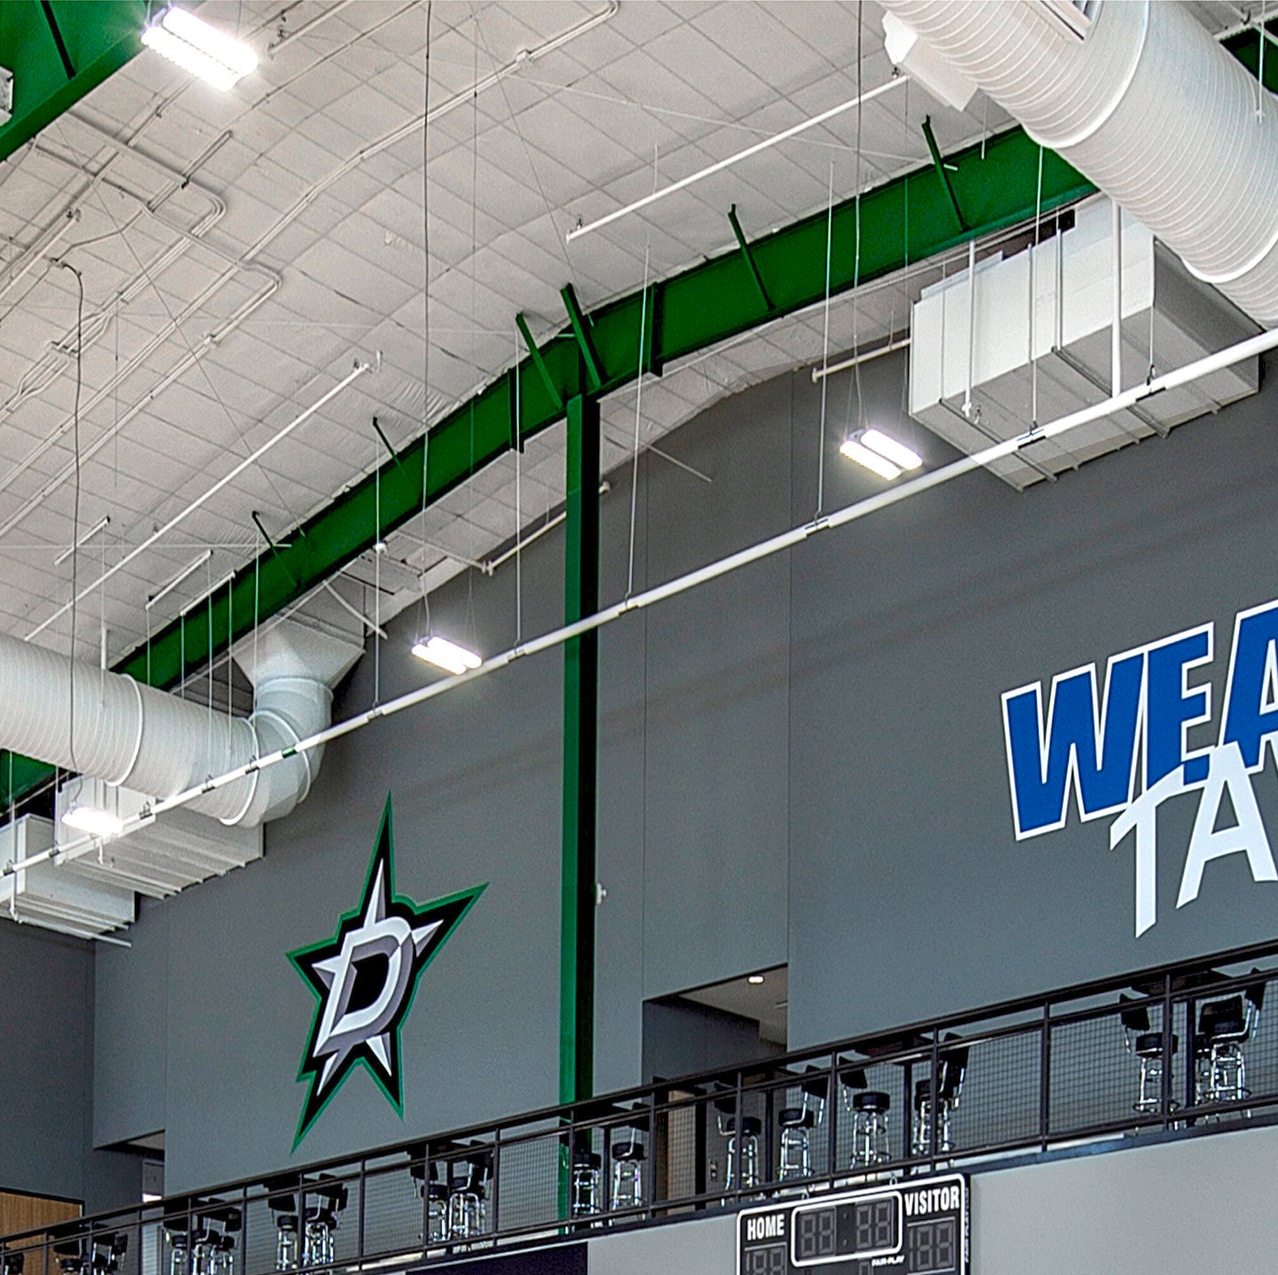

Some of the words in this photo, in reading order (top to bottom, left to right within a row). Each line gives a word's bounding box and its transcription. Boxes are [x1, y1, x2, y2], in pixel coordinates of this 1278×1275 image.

[1001, 621, 1214, 842] WE
[747, 1214, 785, 1240] HOME
[905, 1186, 960, 1216] VISITOR
